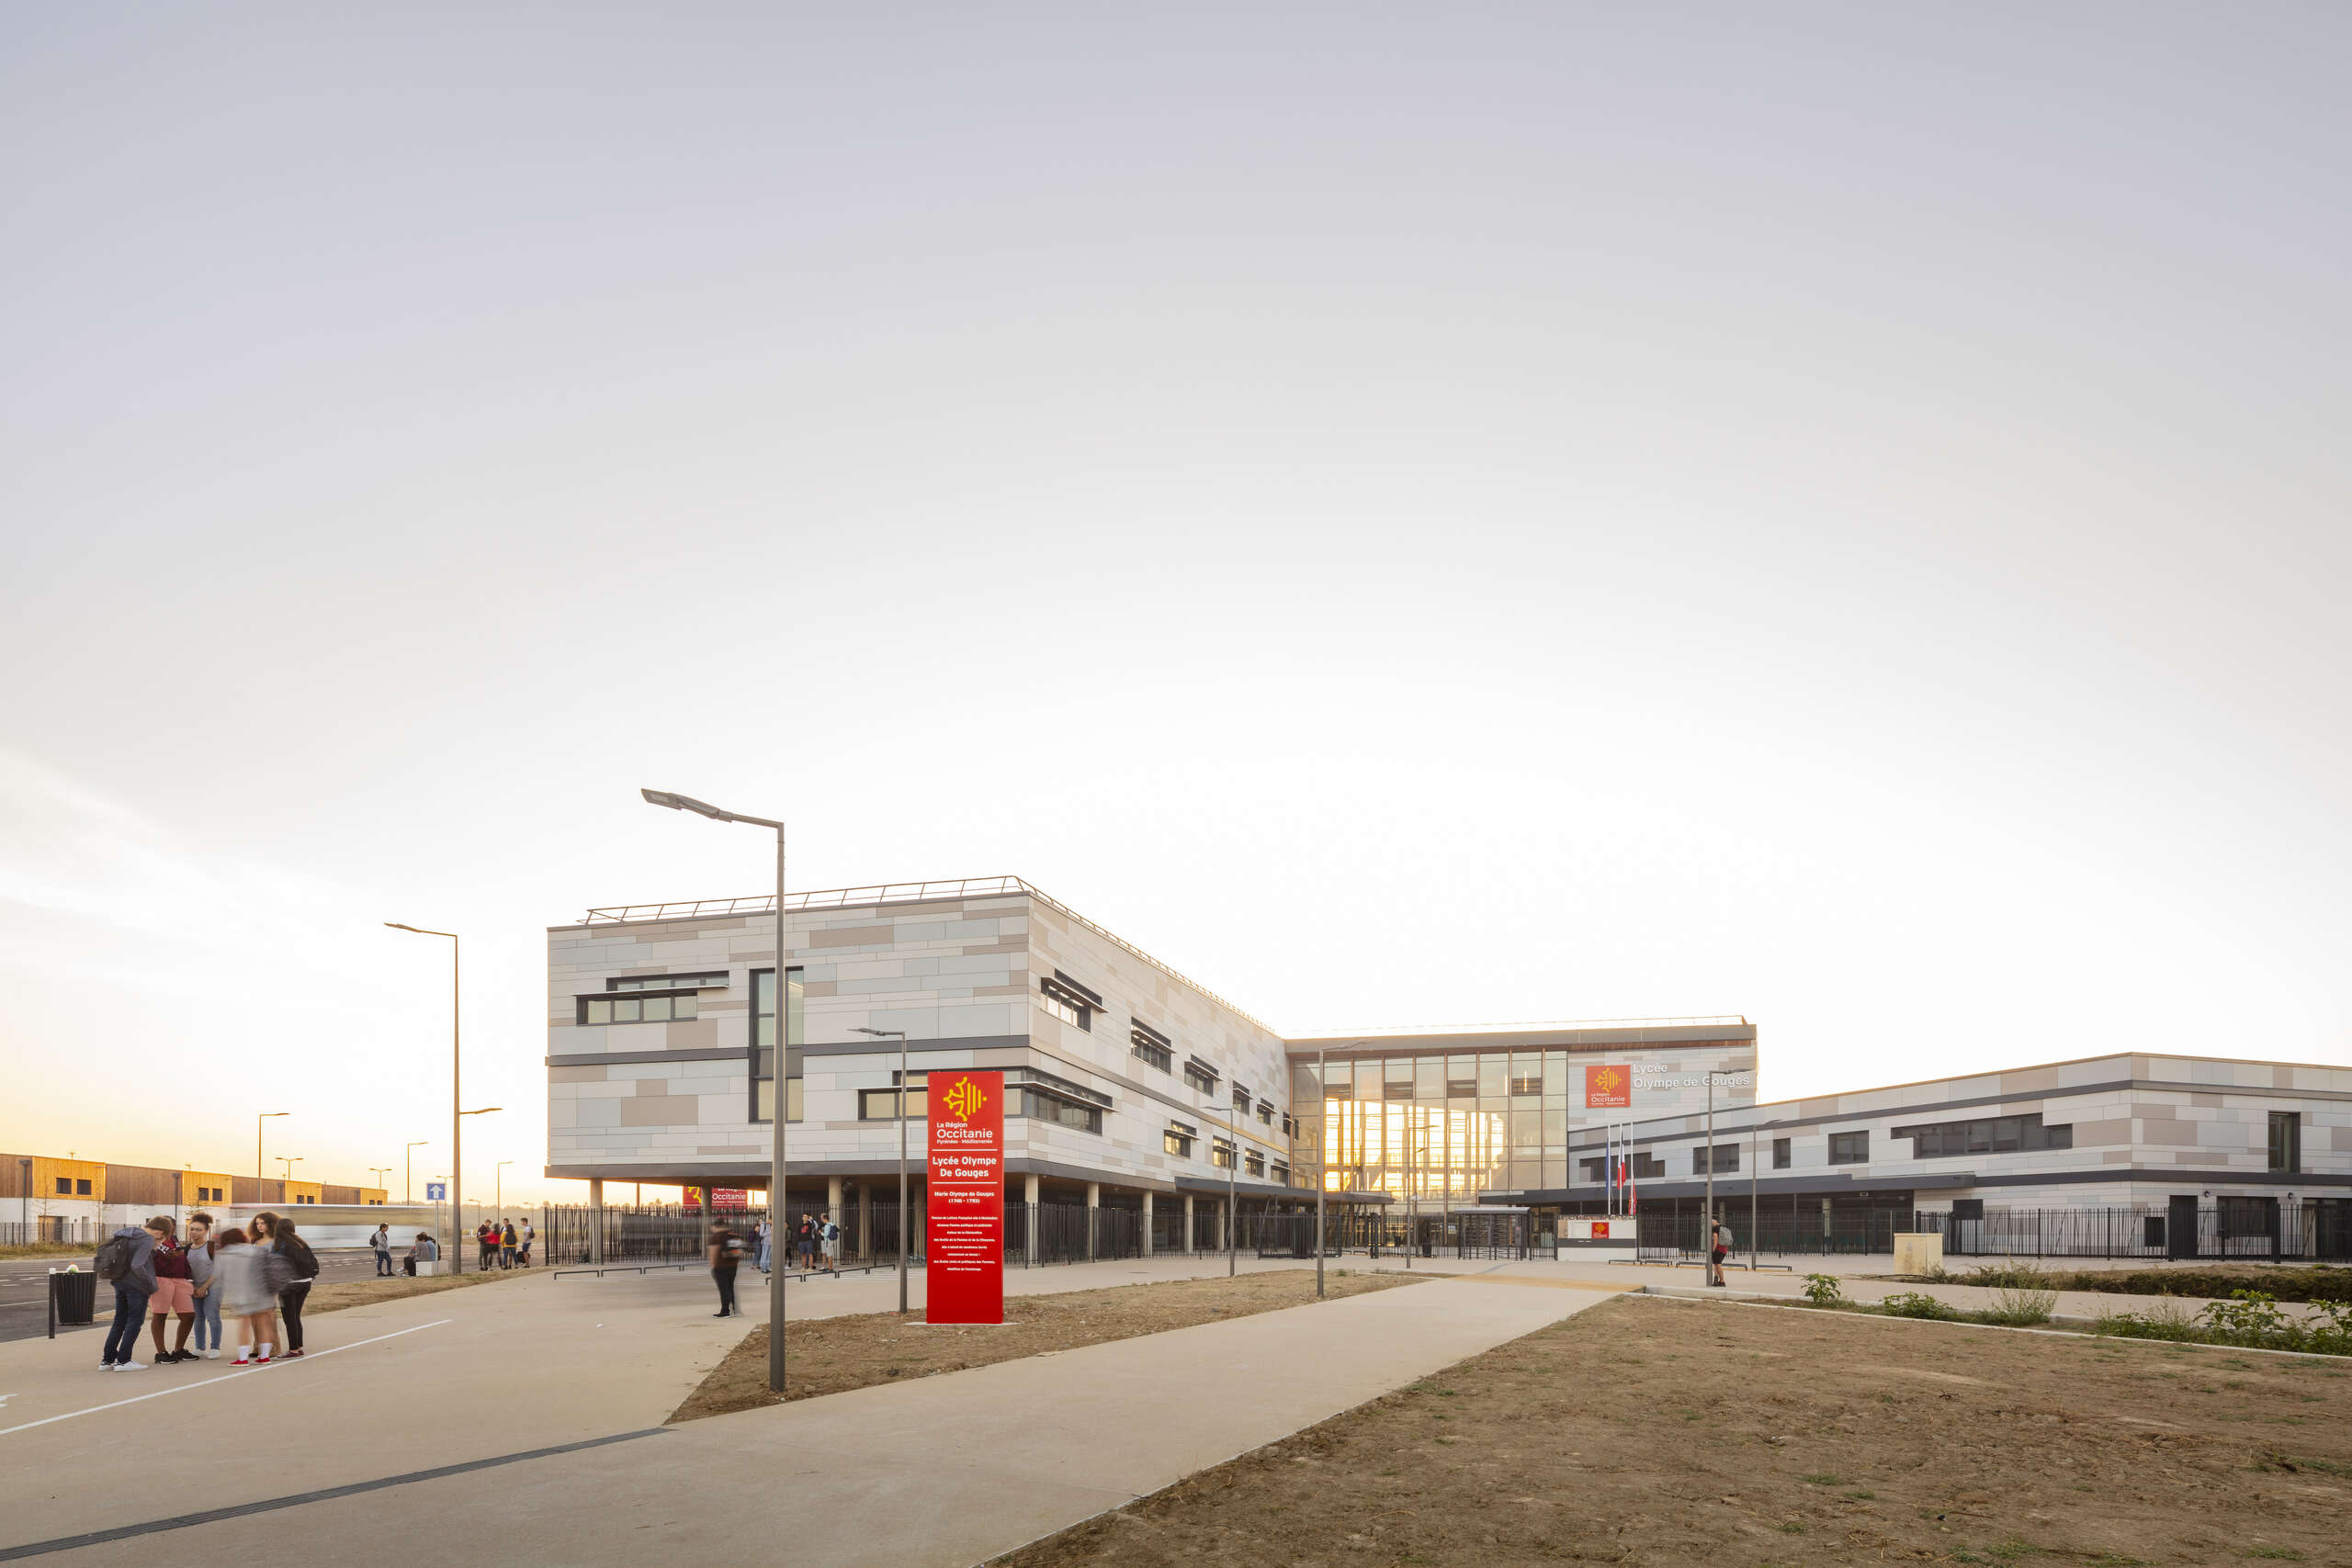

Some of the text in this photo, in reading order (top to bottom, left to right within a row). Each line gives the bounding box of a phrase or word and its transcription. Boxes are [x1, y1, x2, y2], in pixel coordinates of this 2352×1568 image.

[1633, 1063, 1668, 1074] Lycée
[1634, 1075, 1750, 1089] Olympe de Gouges
[936, 1128, 993, 1138] Occitanie
[933, 1155, 997, 1167] Lycée Olympe
[940, 1168, 989, 1179] De Gouges
